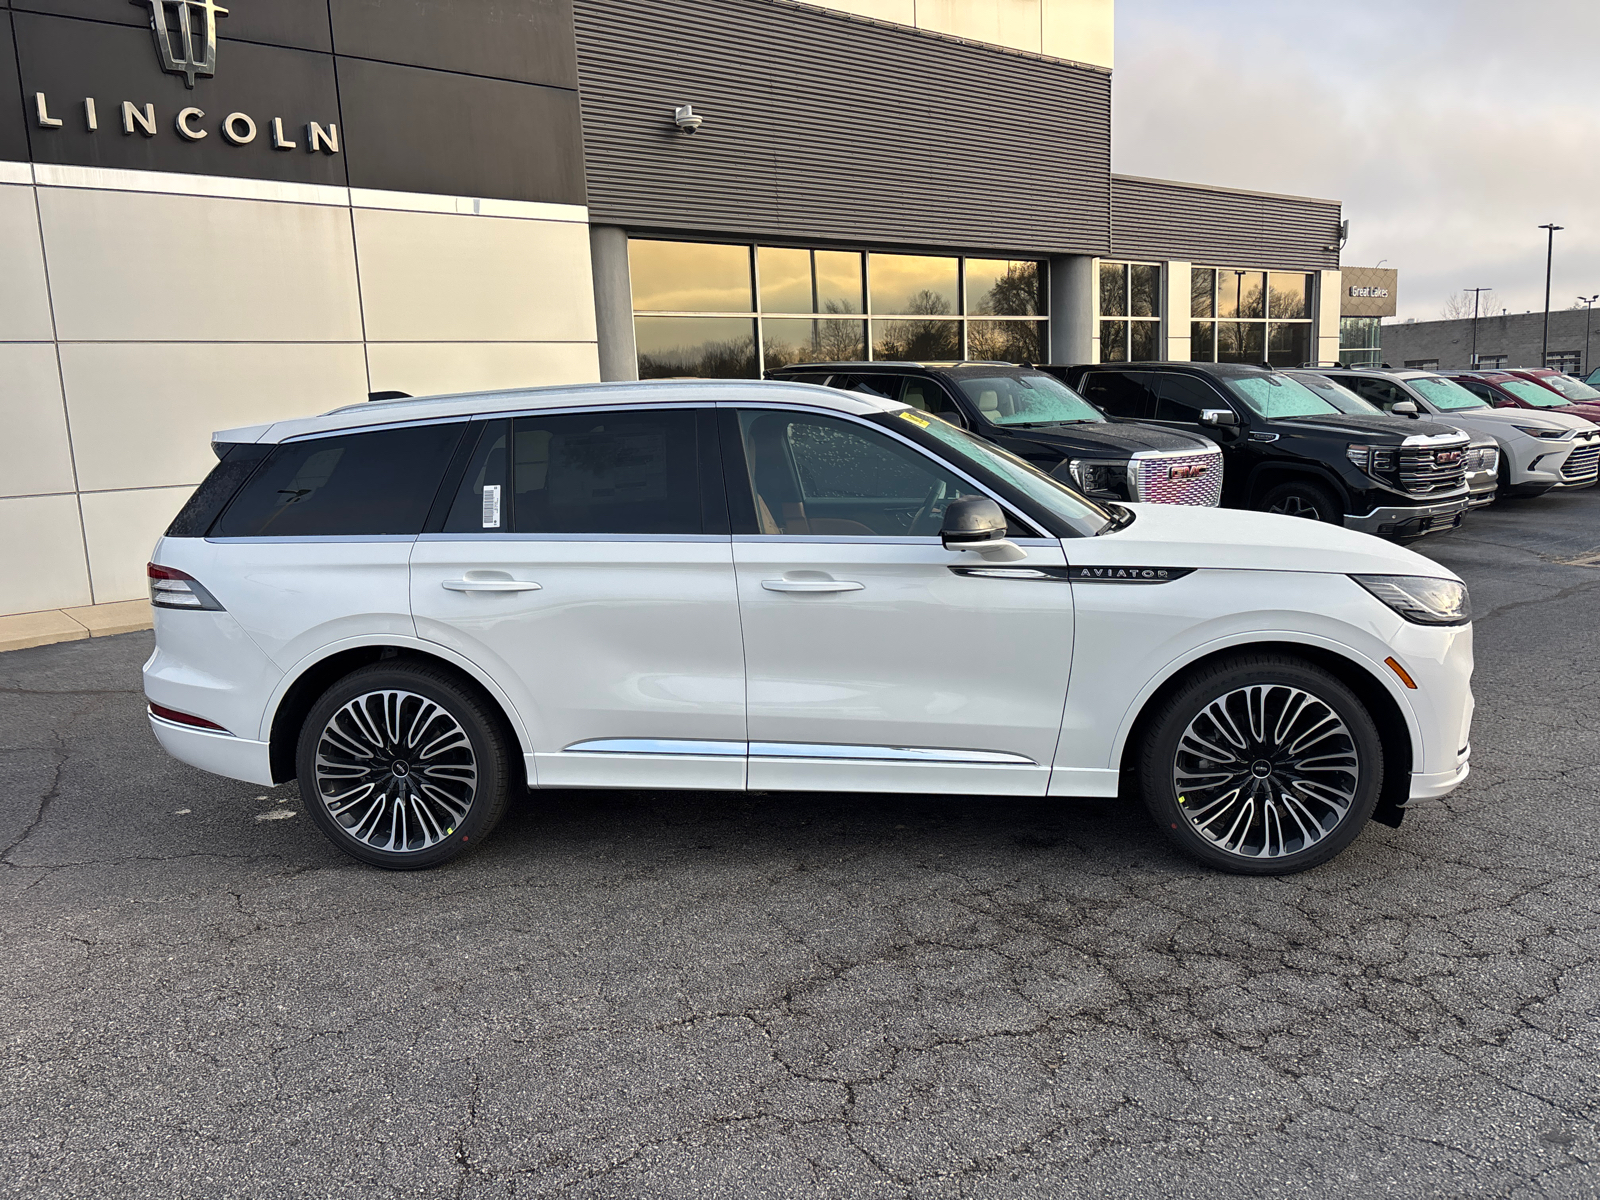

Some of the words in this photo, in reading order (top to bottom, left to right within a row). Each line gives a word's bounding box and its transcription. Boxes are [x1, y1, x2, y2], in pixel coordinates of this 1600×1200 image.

[35, 91, 339, 154] LINCOLN
[1352, 286, 1370, 297] Great
[1371, 287, 1388, 298] Lakes
[1171, 465, 1207, 479] GMC
[1080, 568, 1168, 578] AVIATOR
